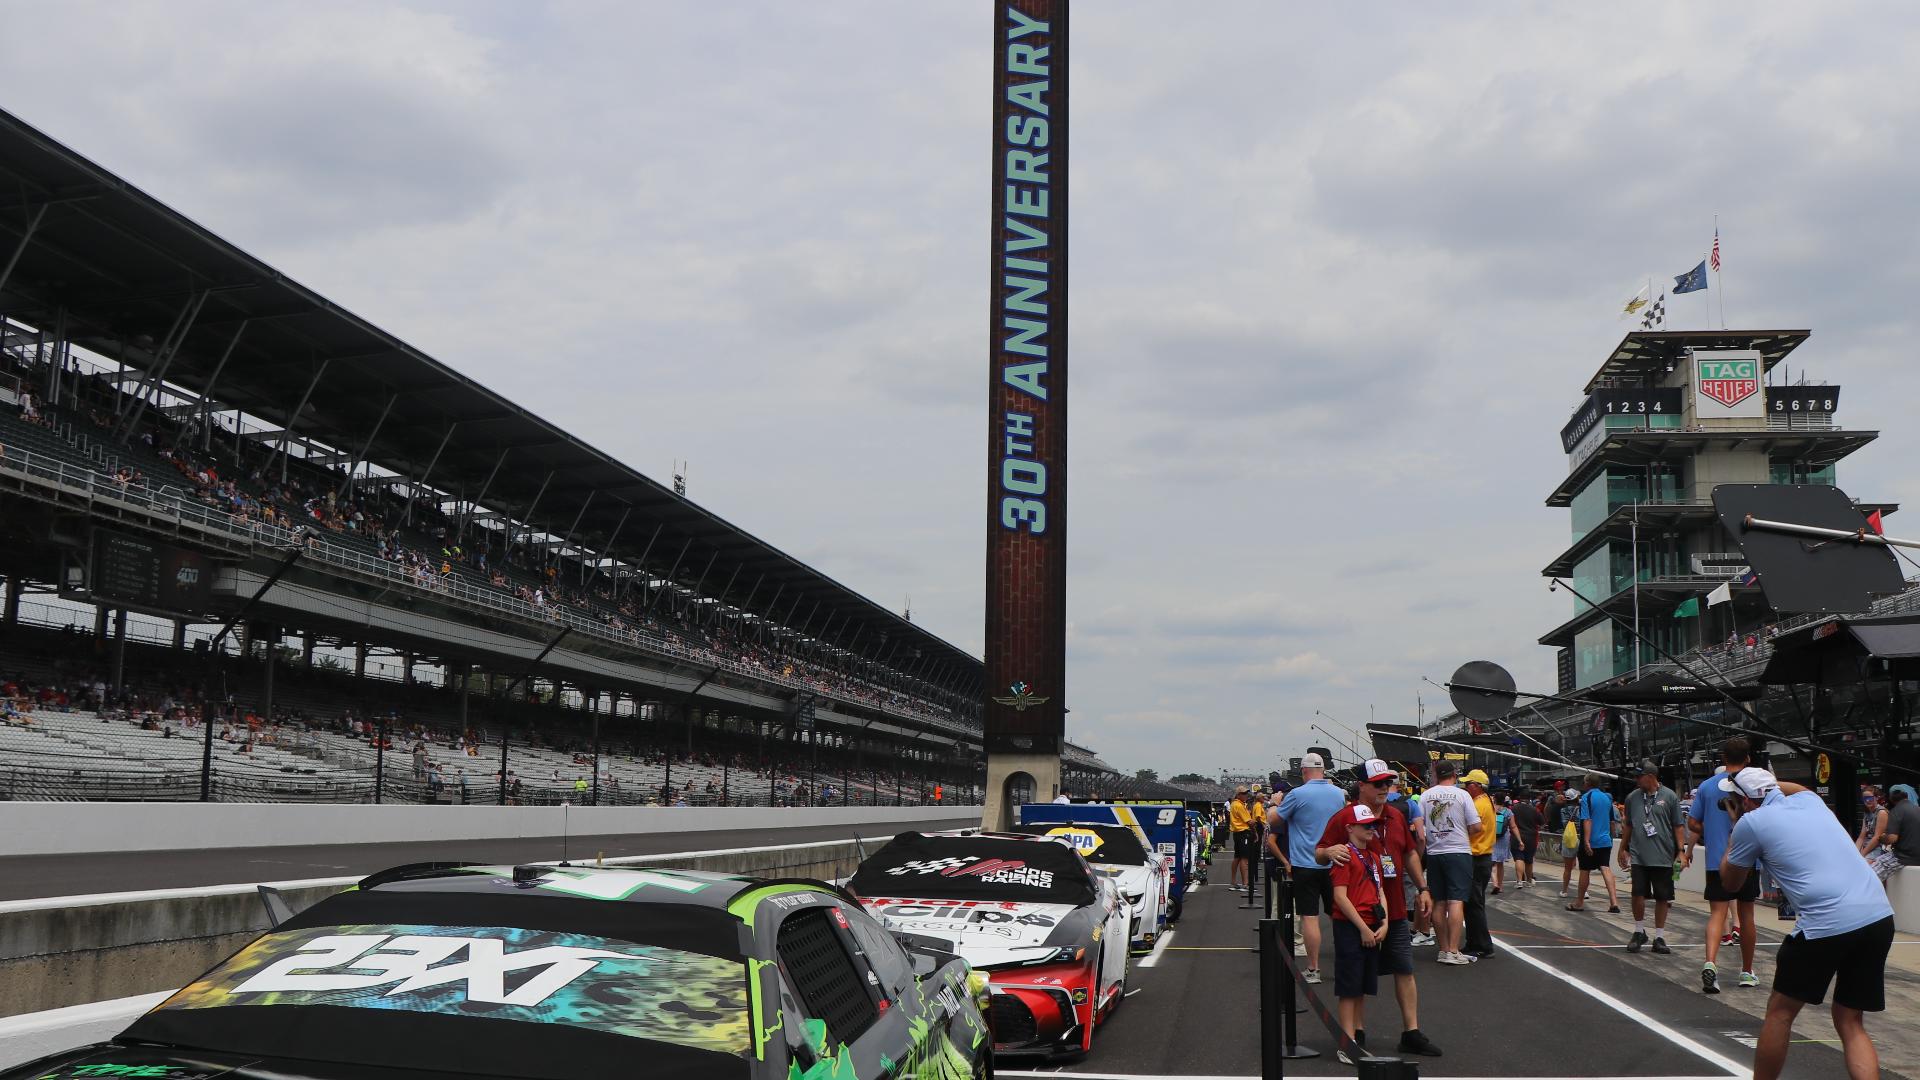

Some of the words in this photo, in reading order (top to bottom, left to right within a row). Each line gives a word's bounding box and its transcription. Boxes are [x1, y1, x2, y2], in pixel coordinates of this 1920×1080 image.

[1004, 7, 1050, 400] ANNIVERSARY
[1703, 363, 1750, 378] TAG
[1702, 380, 1754, 401] HEUER
[1606, 402, 1613, 413] 1
[1621, 401, 1630, 413] 2
[1637, 401, 1646, 413] 3
[1653, 401, 1662, 413] 4
[1775, 400, 1784, 411] 5
[1791, 400, 1800, 411] 6
[1807, 399, 1816, 411] 7
[1824, 399, 1832, 411] 8
[1002, 412, 1046, 534] 30TH
[176, 566, 199, 584] 400
[1156, 809, 1177, 825] 9
[1064, 833, 1094, 849] PA
[981, 875, 1052, 889] RACING
[882, 905, 1056, 928] clips
